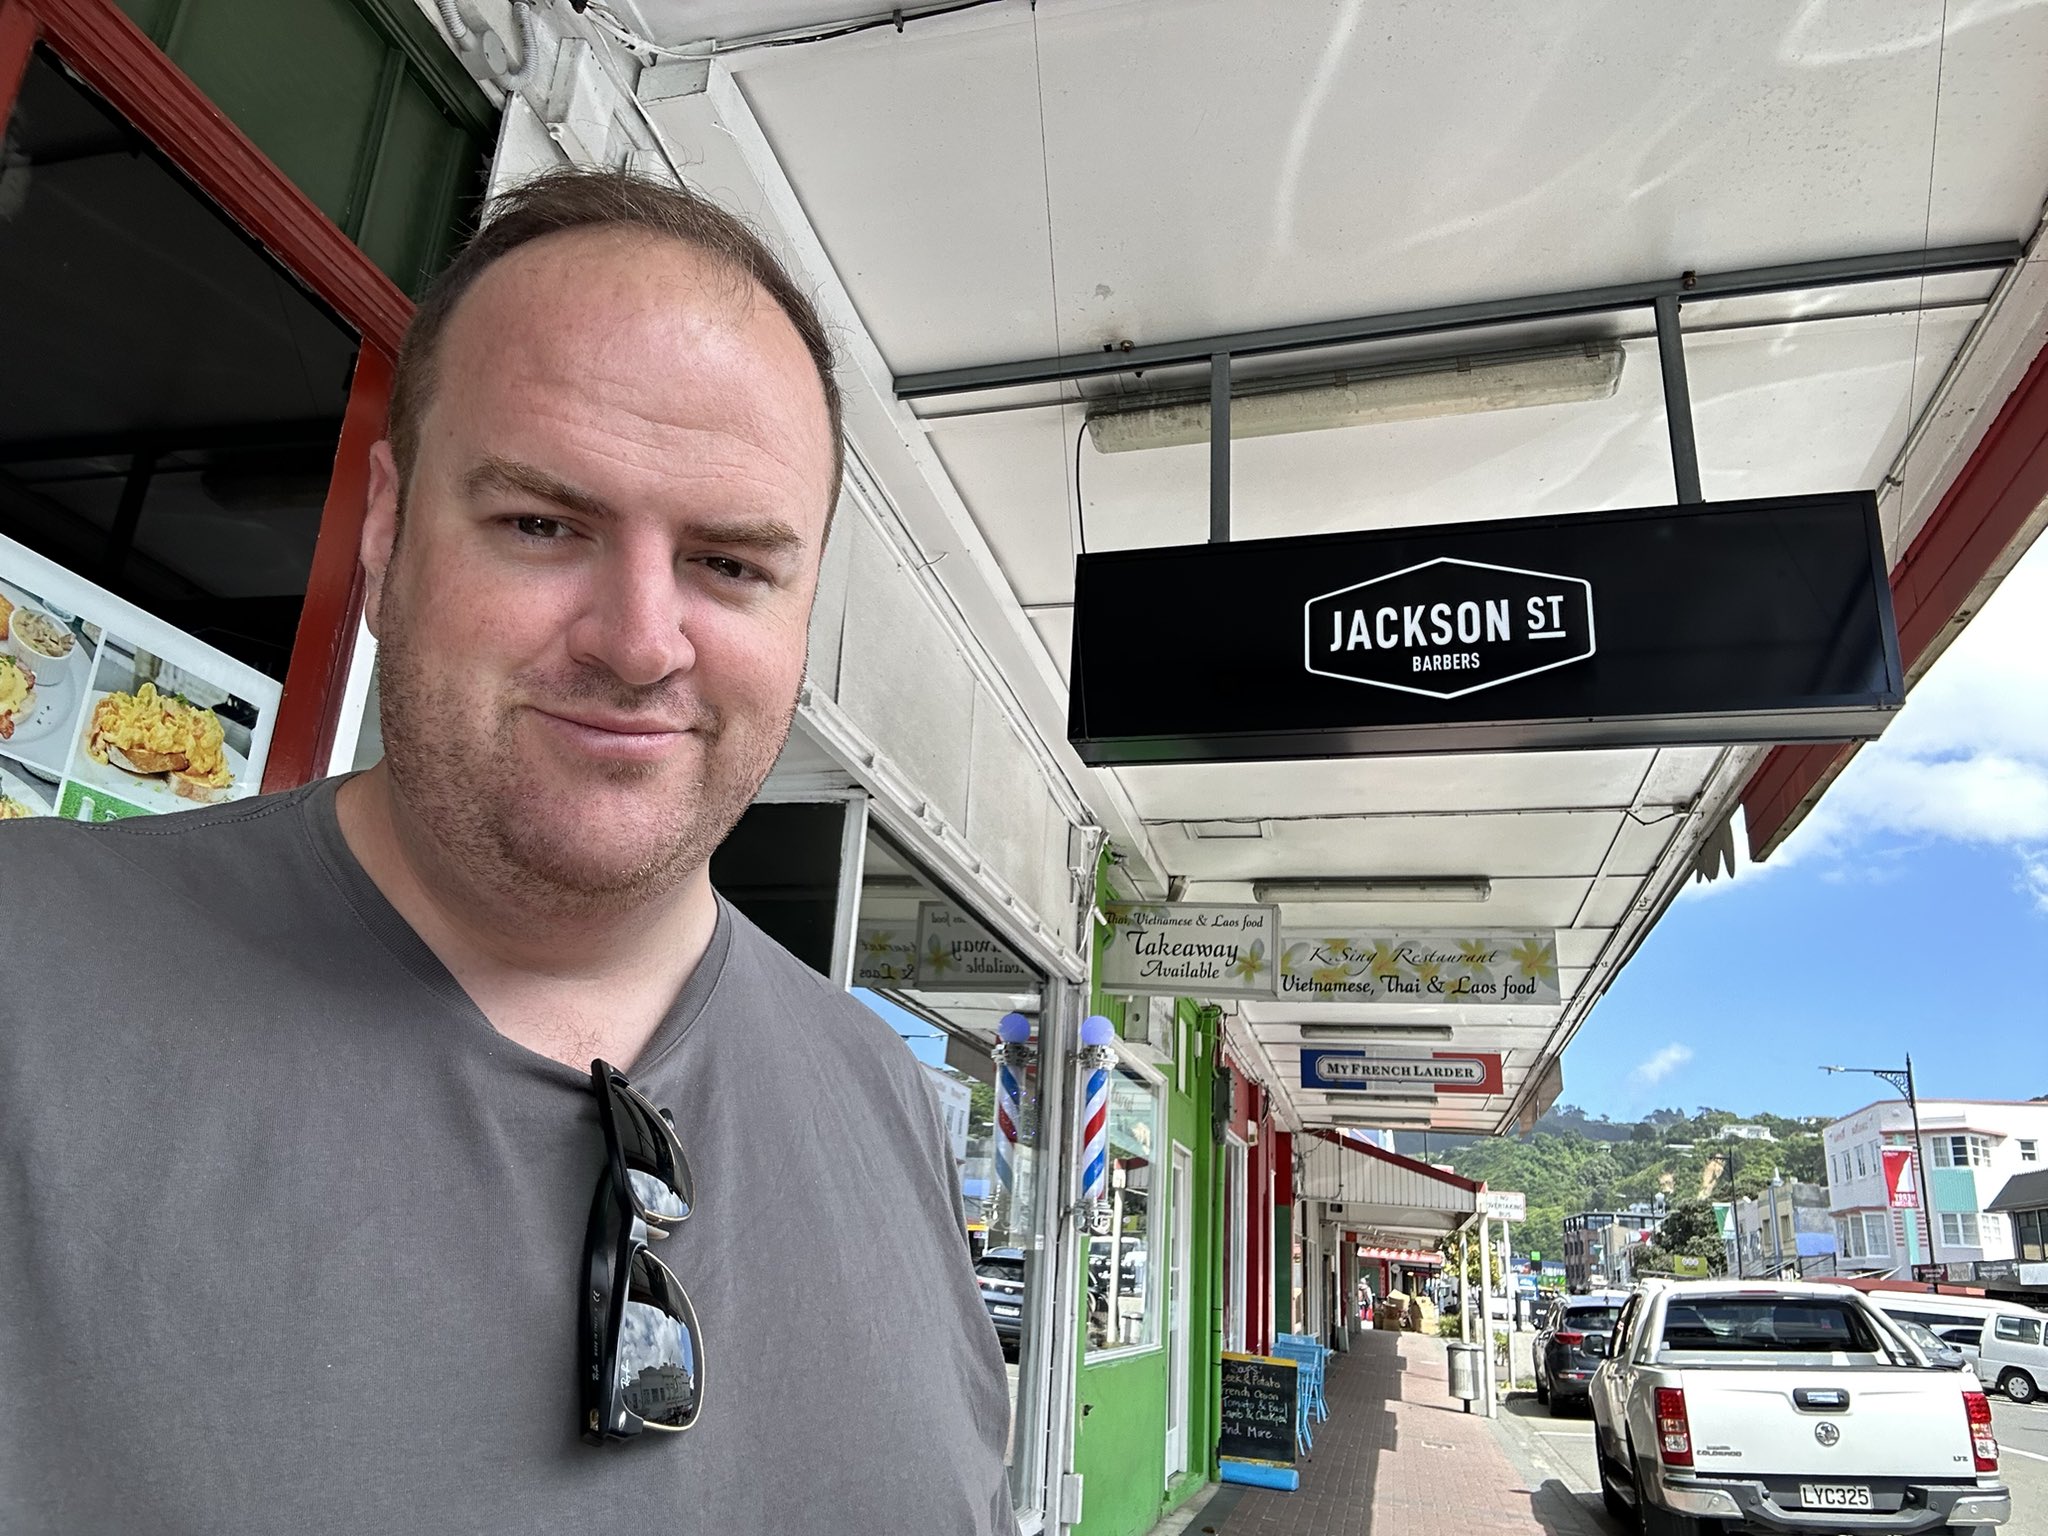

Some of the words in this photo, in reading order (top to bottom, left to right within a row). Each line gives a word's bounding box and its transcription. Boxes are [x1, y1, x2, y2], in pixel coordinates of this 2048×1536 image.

[1330, 599, 1511, 652] JACKSON
[1526, 595, 1566, 632] ST
[1412, 653, 1480, 672] BARBERS
[1133, 913, 1193, 927] Vietnamese
[1195, 914, 1208, 927] &
[1211, 914, 1240, 928] Laos
[1241, 915, 1264, 931] food
[1126, 930, 1239, 967] Takeaway
[1392, 947, 1499, 965] Restaurant
[1140, 959, 1220, 979] Available
[1280, 974, 1375, 996] Vietnamese,
[1380, 975, 1420, 993] Thai
[1427, 976, 1446, 993] &
[1451, 975, 1497, 994] Laos
[1500, 976, 1537, 1000] food
[1327, 1063, 1349, 1075] MY
[1352, 1064, 1411, 1077] FRENCH
[1414, 1065, 1475, 1078] LARDER
[1802, 1487, 1869, 1505] LYC325
